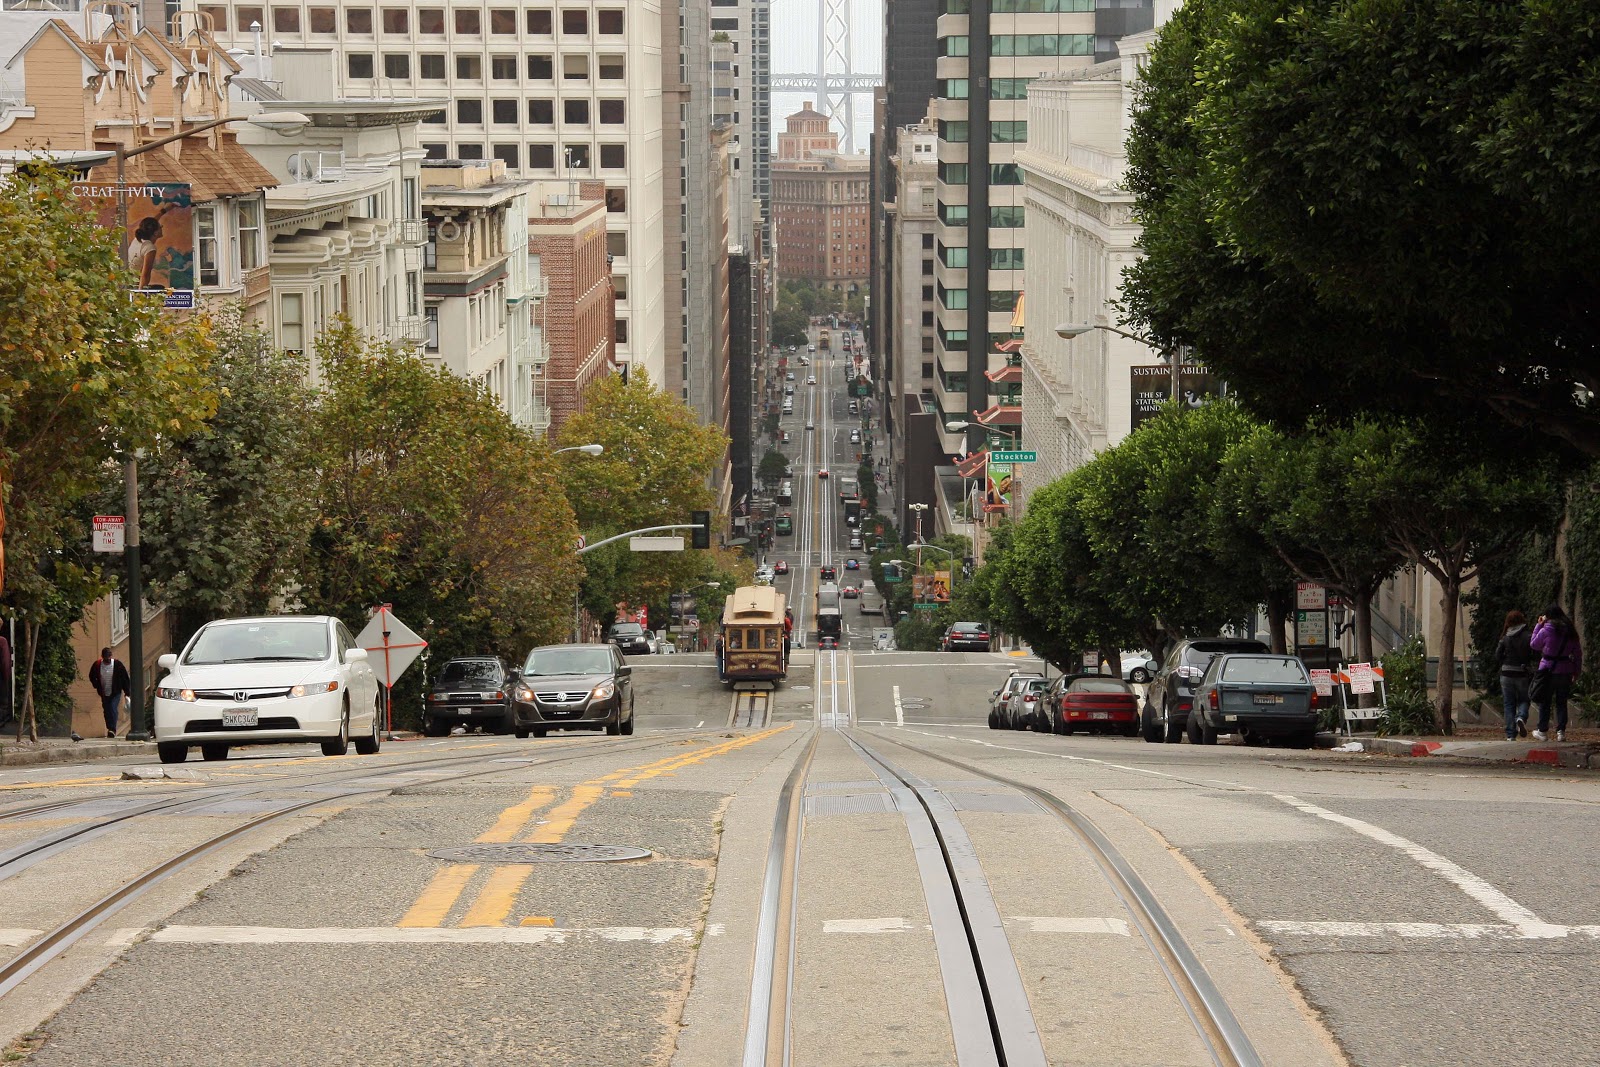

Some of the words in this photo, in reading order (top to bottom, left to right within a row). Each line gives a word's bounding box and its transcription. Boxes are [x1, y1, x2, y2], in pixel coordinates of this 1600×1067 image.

[93, 523, 102, 531] NO
[1299, 613, 1304, 621] 2
[225, 715, 255, 723] 5WKC346
